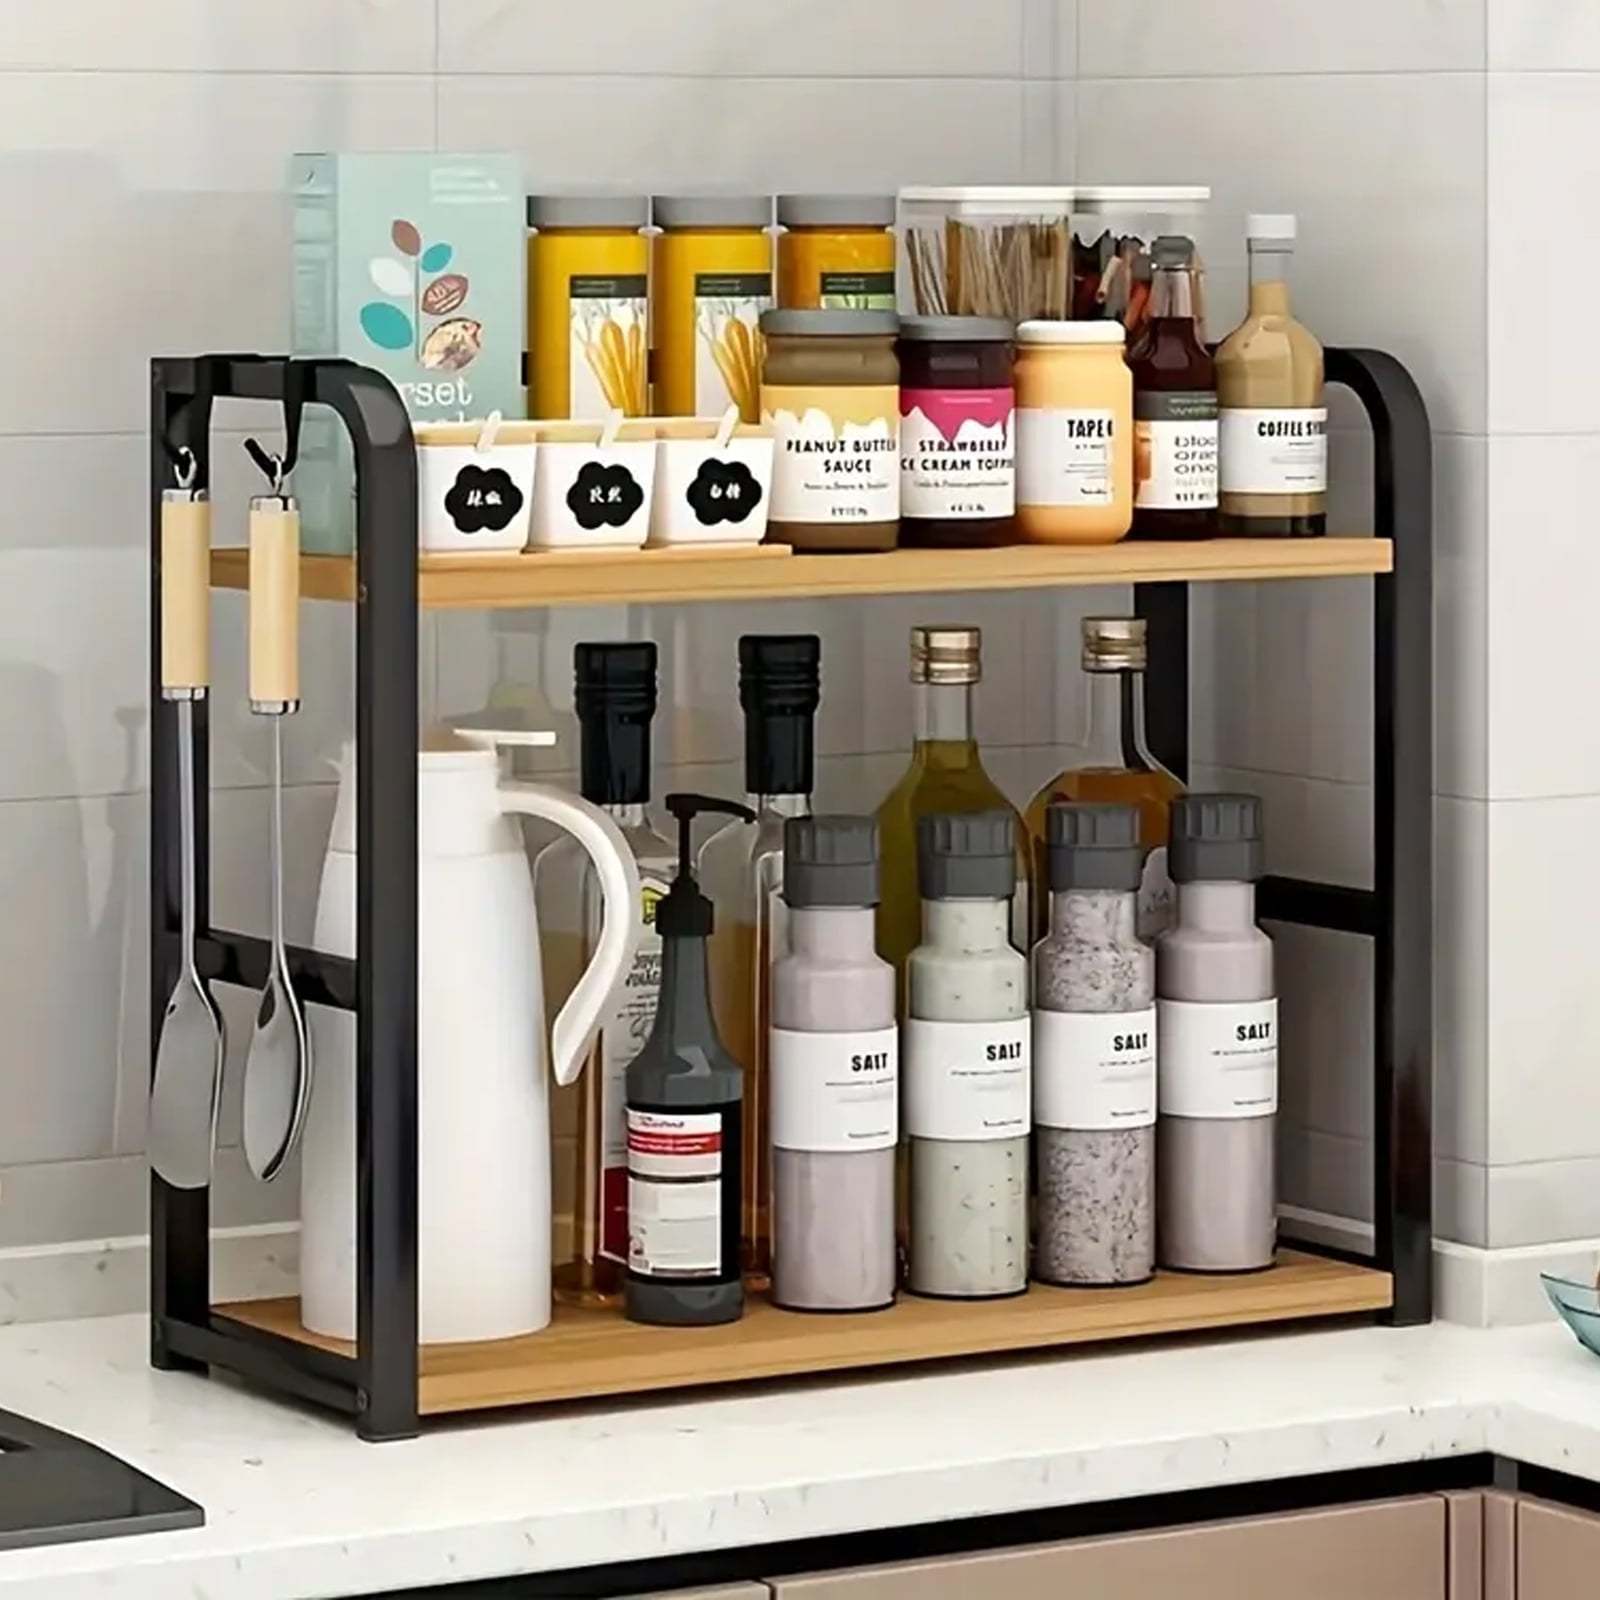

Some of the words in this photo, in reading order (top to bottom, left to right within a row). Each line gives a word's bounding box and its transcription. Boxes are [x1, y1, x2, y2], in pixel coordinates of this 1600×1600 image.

[1067, 419, 1104, 438] TAPE
[786, 439, 846, 453] PEANUT
[823, 459, 872, 474] SAUCE
[921, 459, 971, 472] CREAM
[1236, 1022, 1272, 1042] SALT
[986, 1041, 1022, 1062] SALT
[1113, 1032, 1149, 1052] SALT
[852, 1052, 889, 1073] SALT
